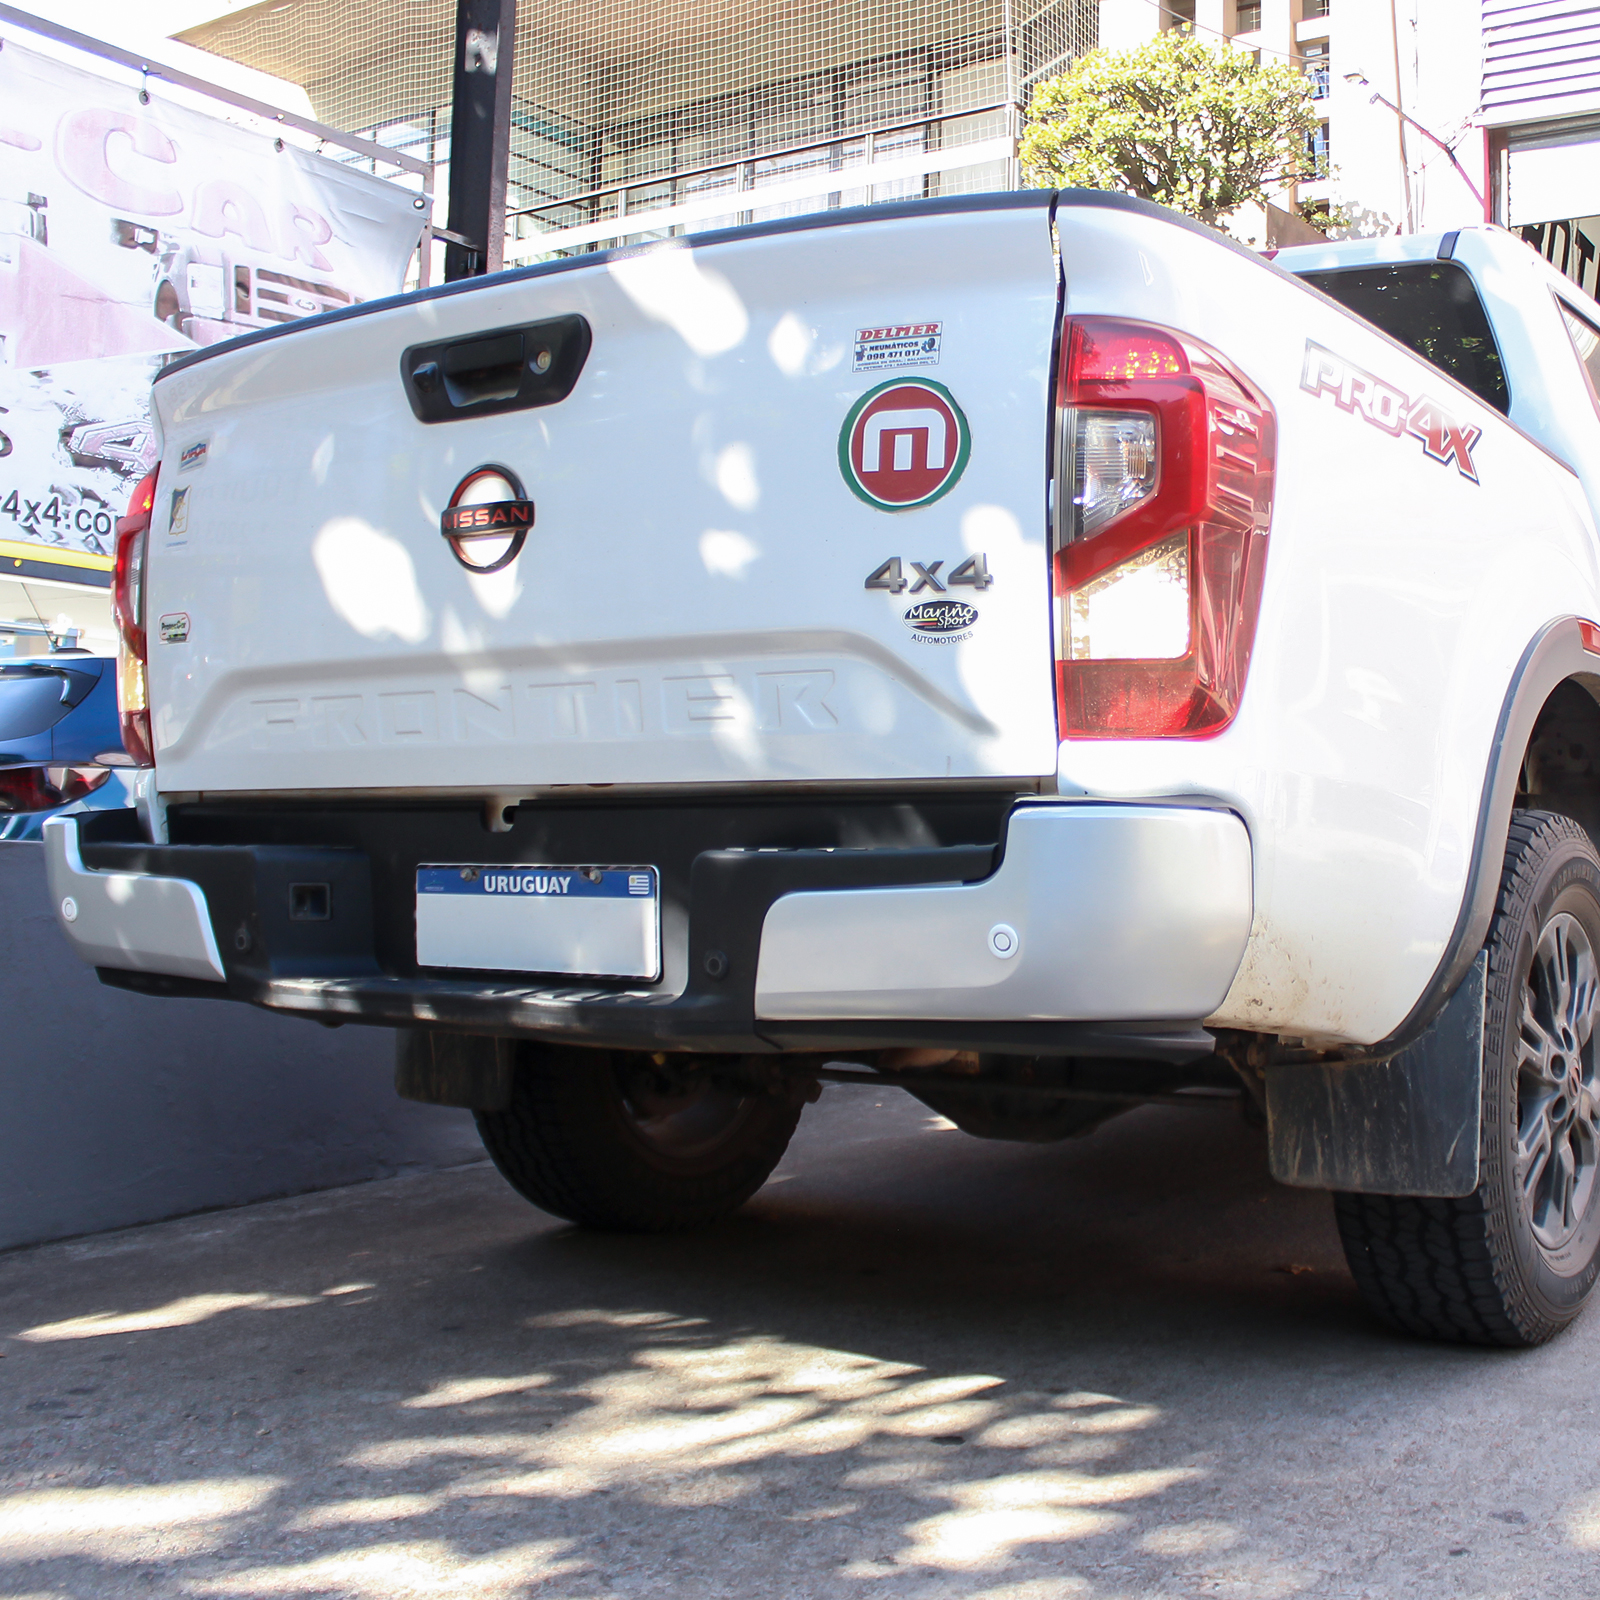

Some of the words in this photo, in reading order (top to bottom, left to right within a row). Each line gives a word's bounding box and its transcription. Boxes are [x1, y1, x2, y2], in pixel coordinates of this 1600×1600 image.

[860, 323, 939, 341] DELMER
[867, 352, 885, 361] 098
[887, 350, 903, 359] 471
[905, 349, 921, 357] 017
[869, 341, 919, 352] NEUMÁTICOS
[0, 489, 125, 536] 4x4.co
[442, 505, 529, 530] NISSAN
[865, 553, 993, 594] 4x4
[909, 604, 976, 619] Mariño
[937, 616, 973, 629] Sport
[911, 631, 974, 644] AUTOMOTORES
[250, 669, 839, 751] FRONTIER
[484, 875, 571, 894] URUGUAY
